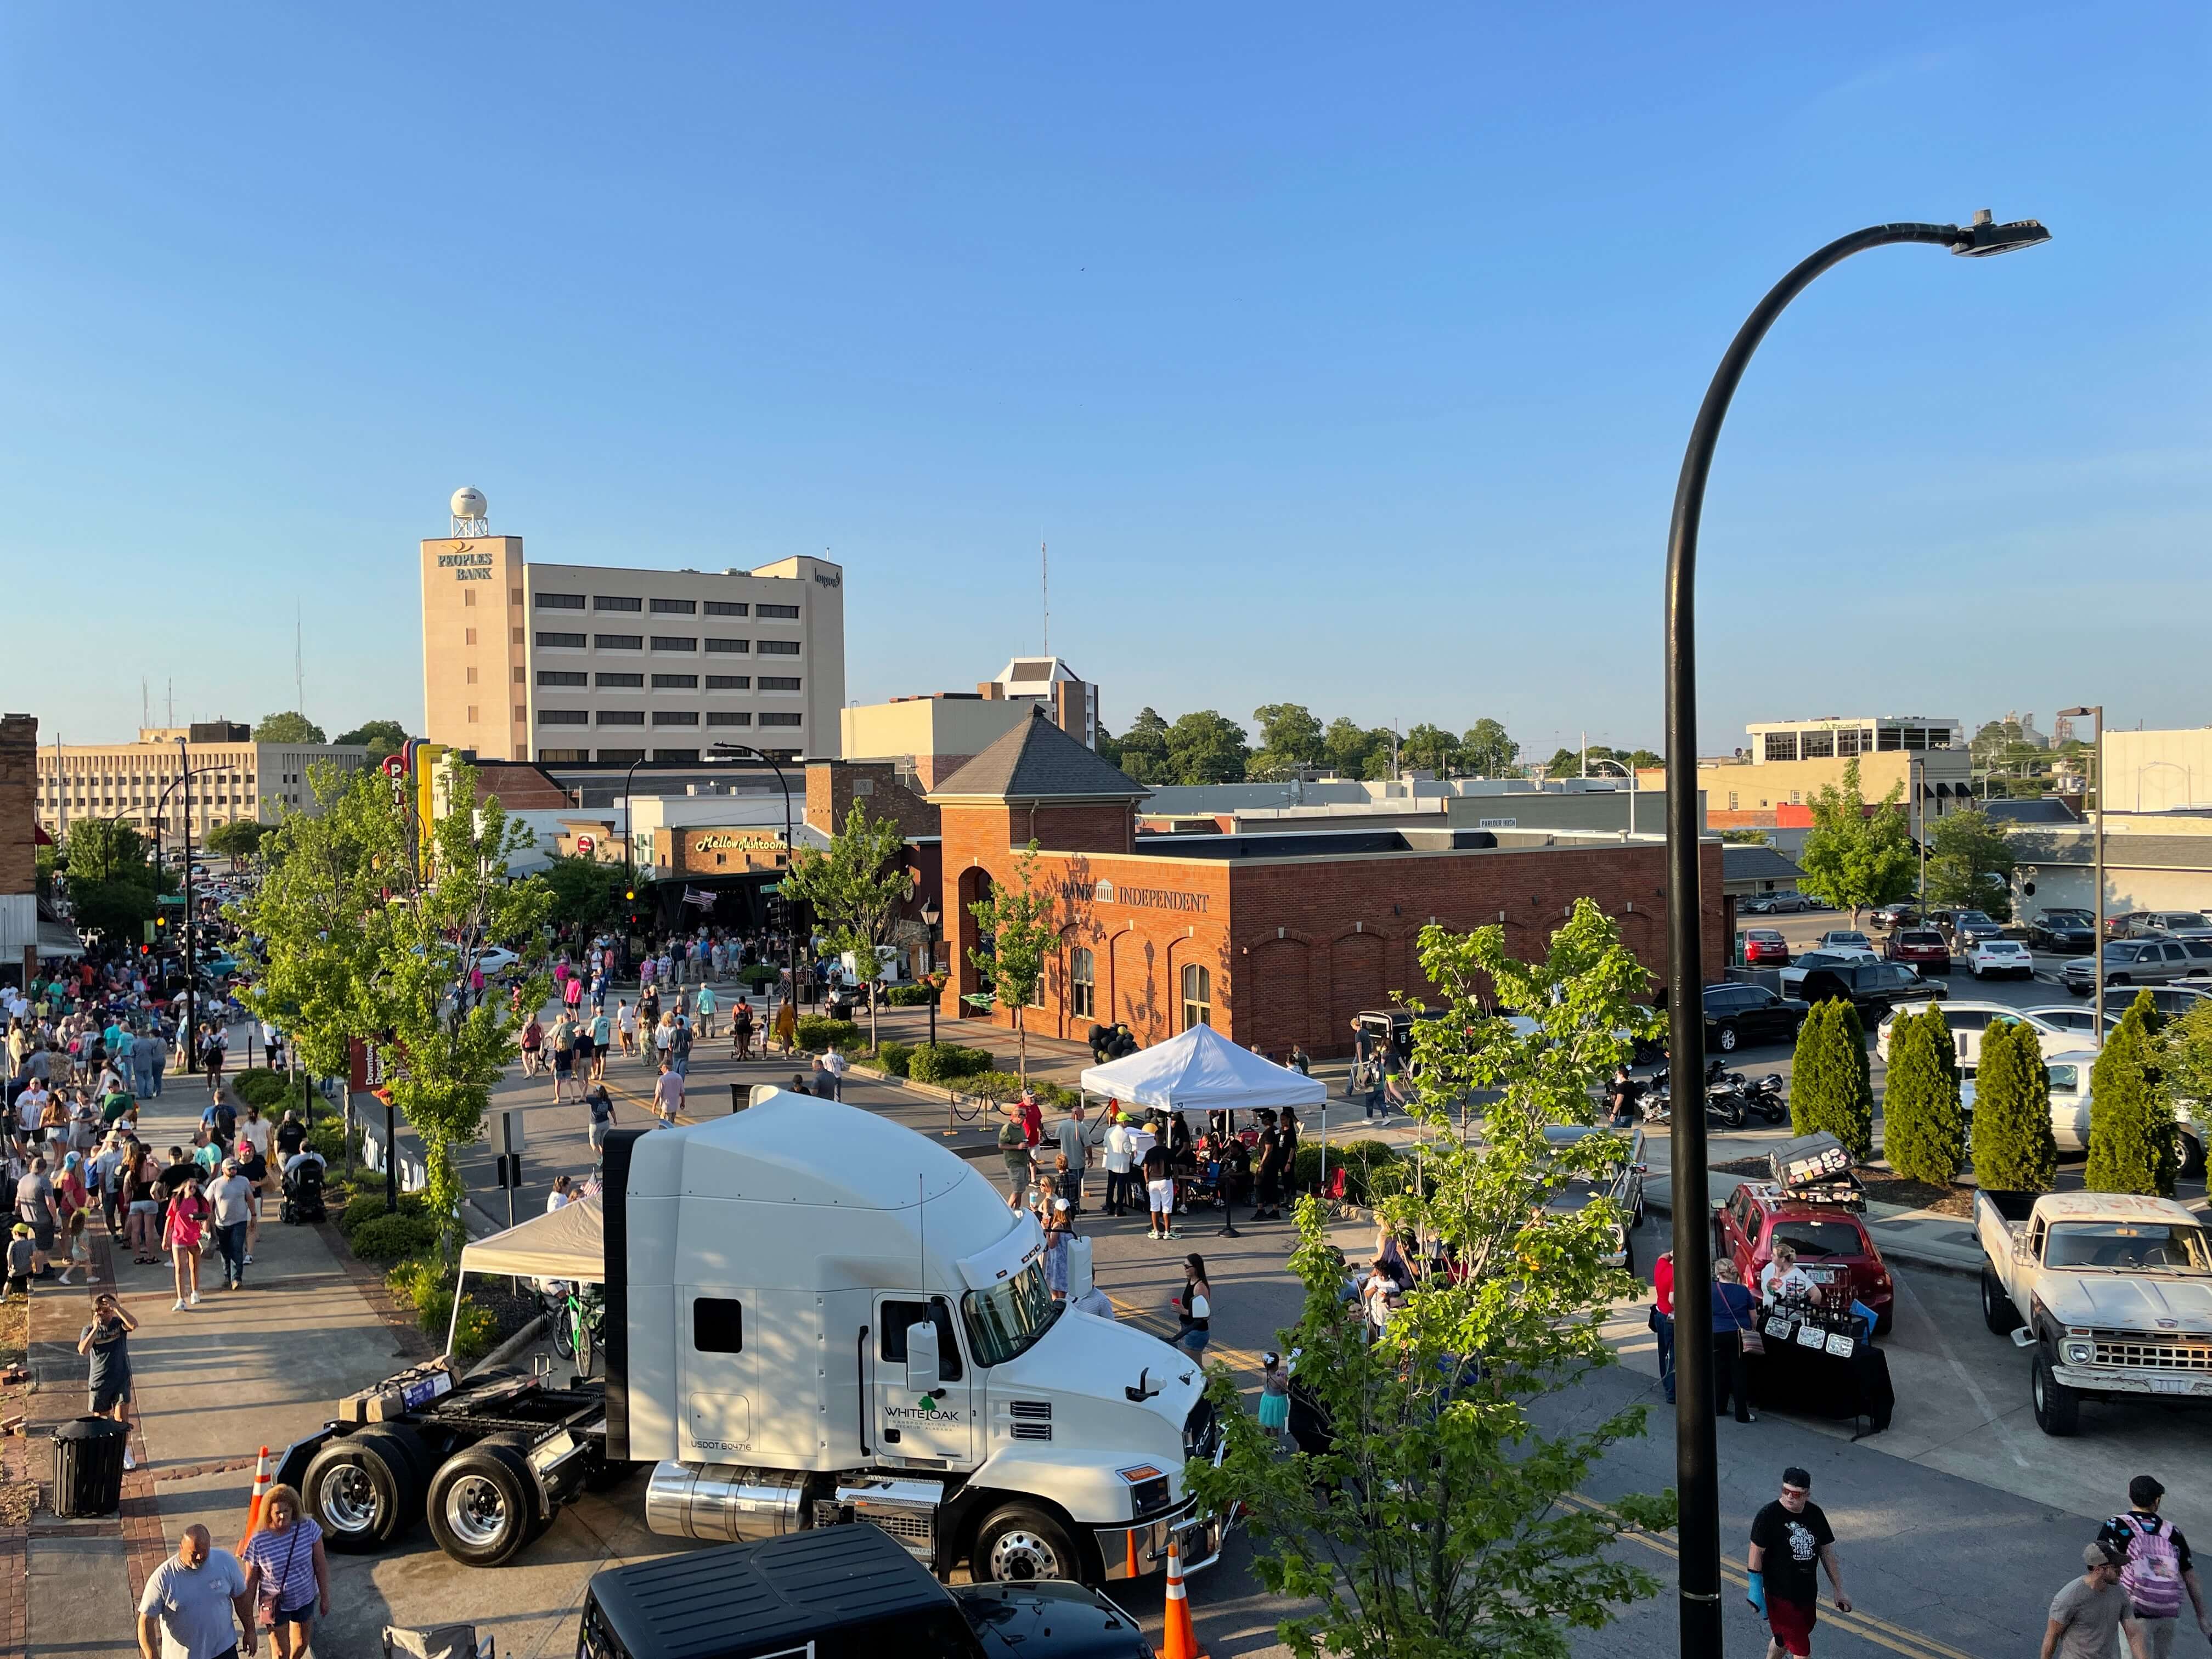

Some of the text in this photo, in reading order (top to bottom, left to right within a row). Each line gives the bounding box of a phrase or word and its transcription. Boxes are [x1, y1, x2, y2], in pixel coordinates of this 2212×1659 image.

[437, 553, 493, 567] PEOPLES
[455, 567, 493, 580] BANK
[695, 835, 788, 852] Mellow Mushroom
[1062, 881, 1209, 913] BANK INDEPENDENT
[365, 1043, 374, 1085] Downtow
[884, 1407, 959, 1420] WHITE OAK
[533, 1424, 561, 1444] MACK
[691, 1440, 752, 1451] USDOT 804716
[1791, 1536, 1813, 1545] SPACE
